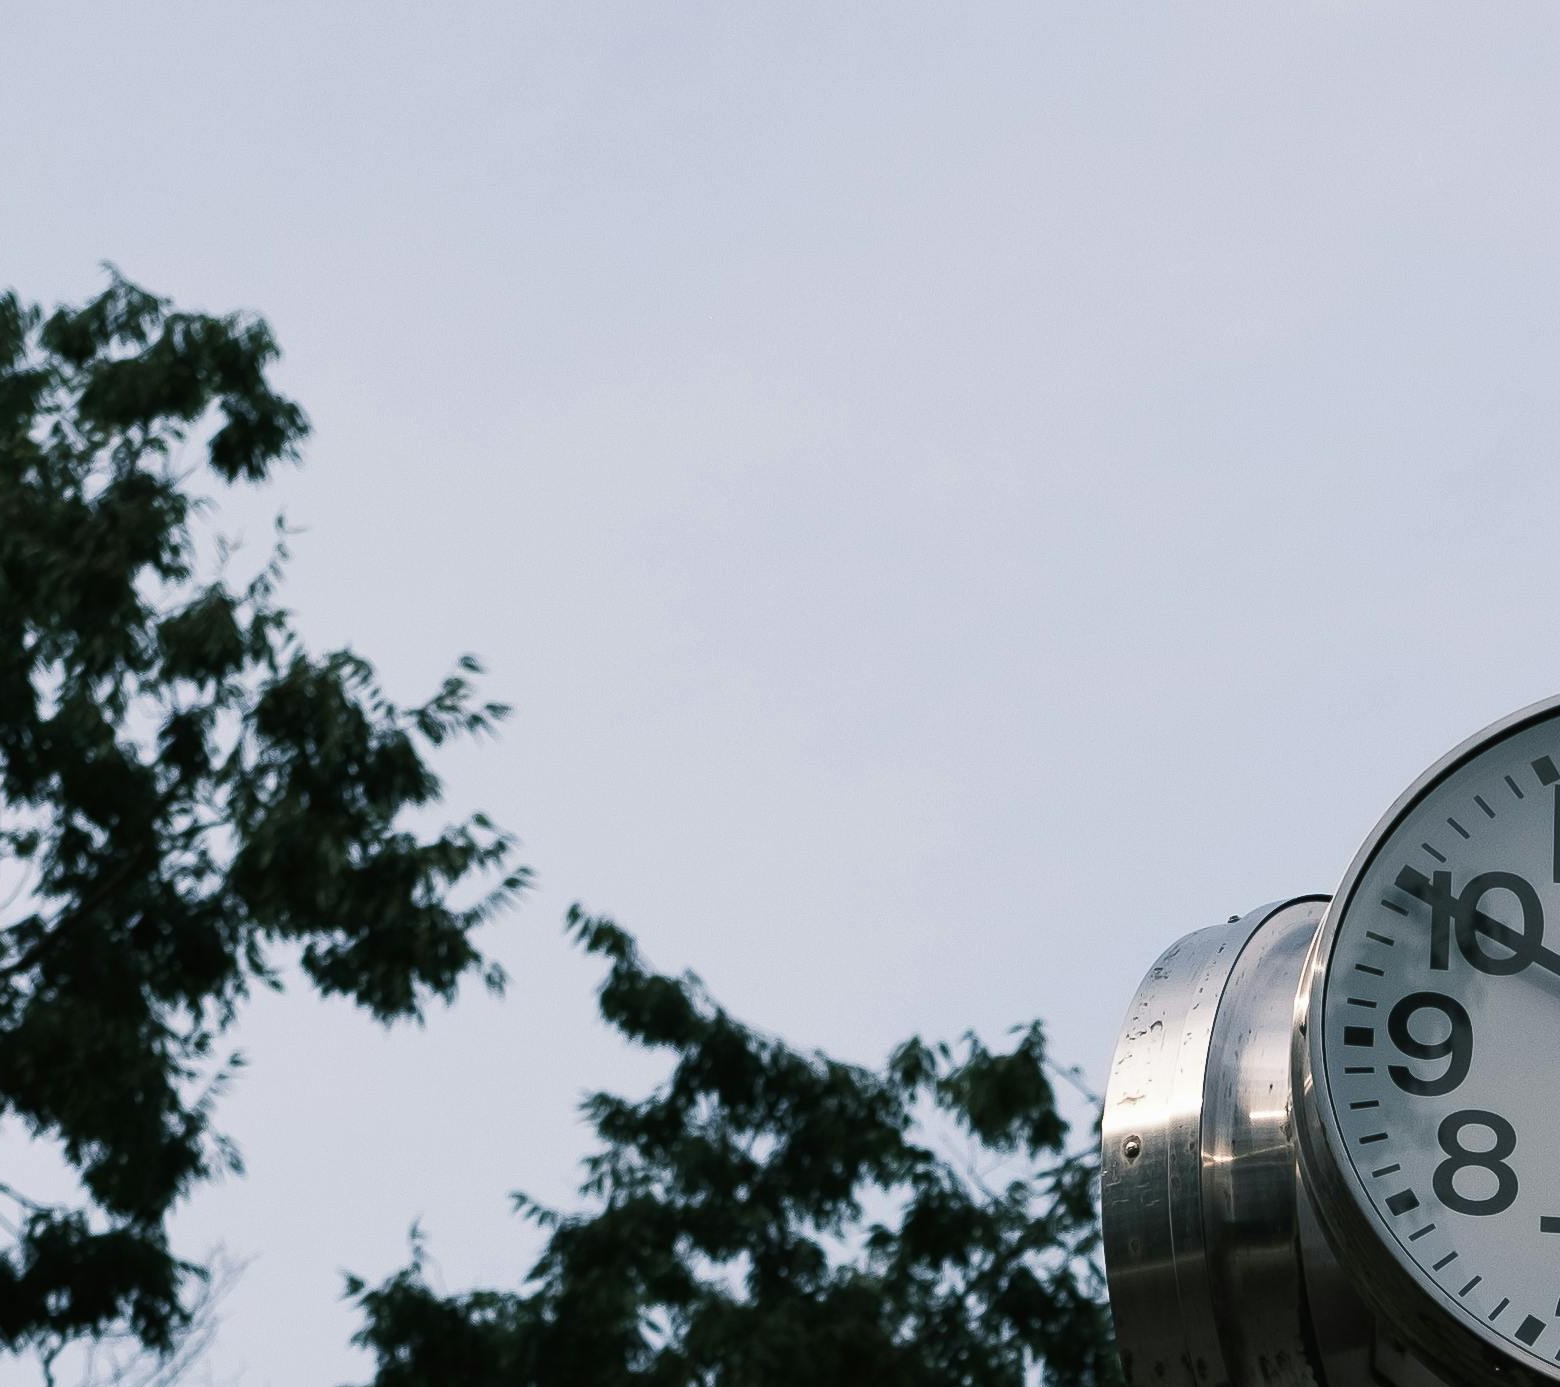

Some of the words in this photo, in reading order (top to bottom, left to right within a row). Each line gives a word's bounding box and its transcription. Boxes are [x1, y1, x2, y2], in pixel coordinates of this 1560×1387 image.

[1431, 870, 1544, 977] 10
[1386, 991, 1474, 1097] 9
[1431, 1109, 1520, 1216] 8
